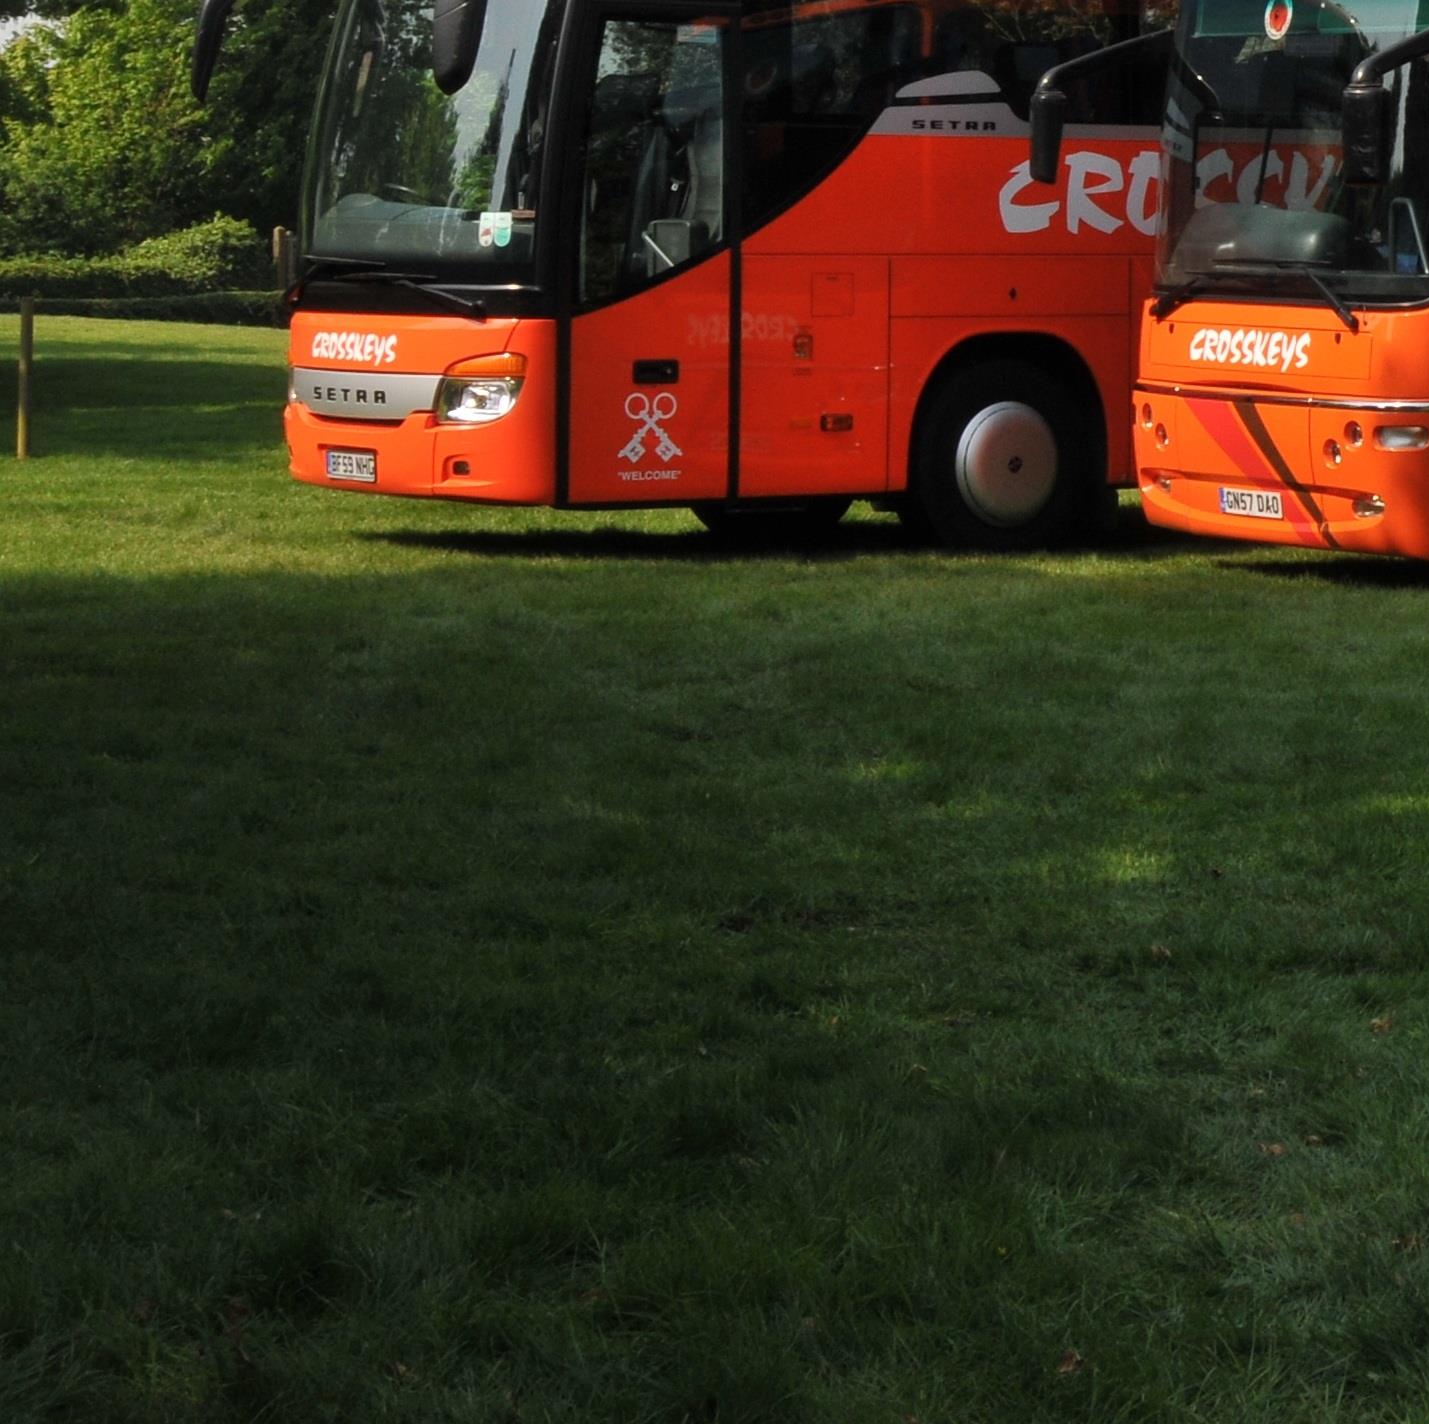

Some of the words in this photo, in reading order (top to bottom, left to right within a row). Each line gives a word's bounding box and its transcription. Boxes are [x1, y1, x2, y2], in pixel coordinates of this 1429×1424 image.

[912, 119, 996, 131] SETRA
[312, 332, 397, 366] CROSSKEYS
[1190, 329, 1311, 373] CROSSKEYS
[313, 387, 387, 404] SETRA
[331, 454, 353, 473] BF59
[1226, 491, 1253, 511] GN57
